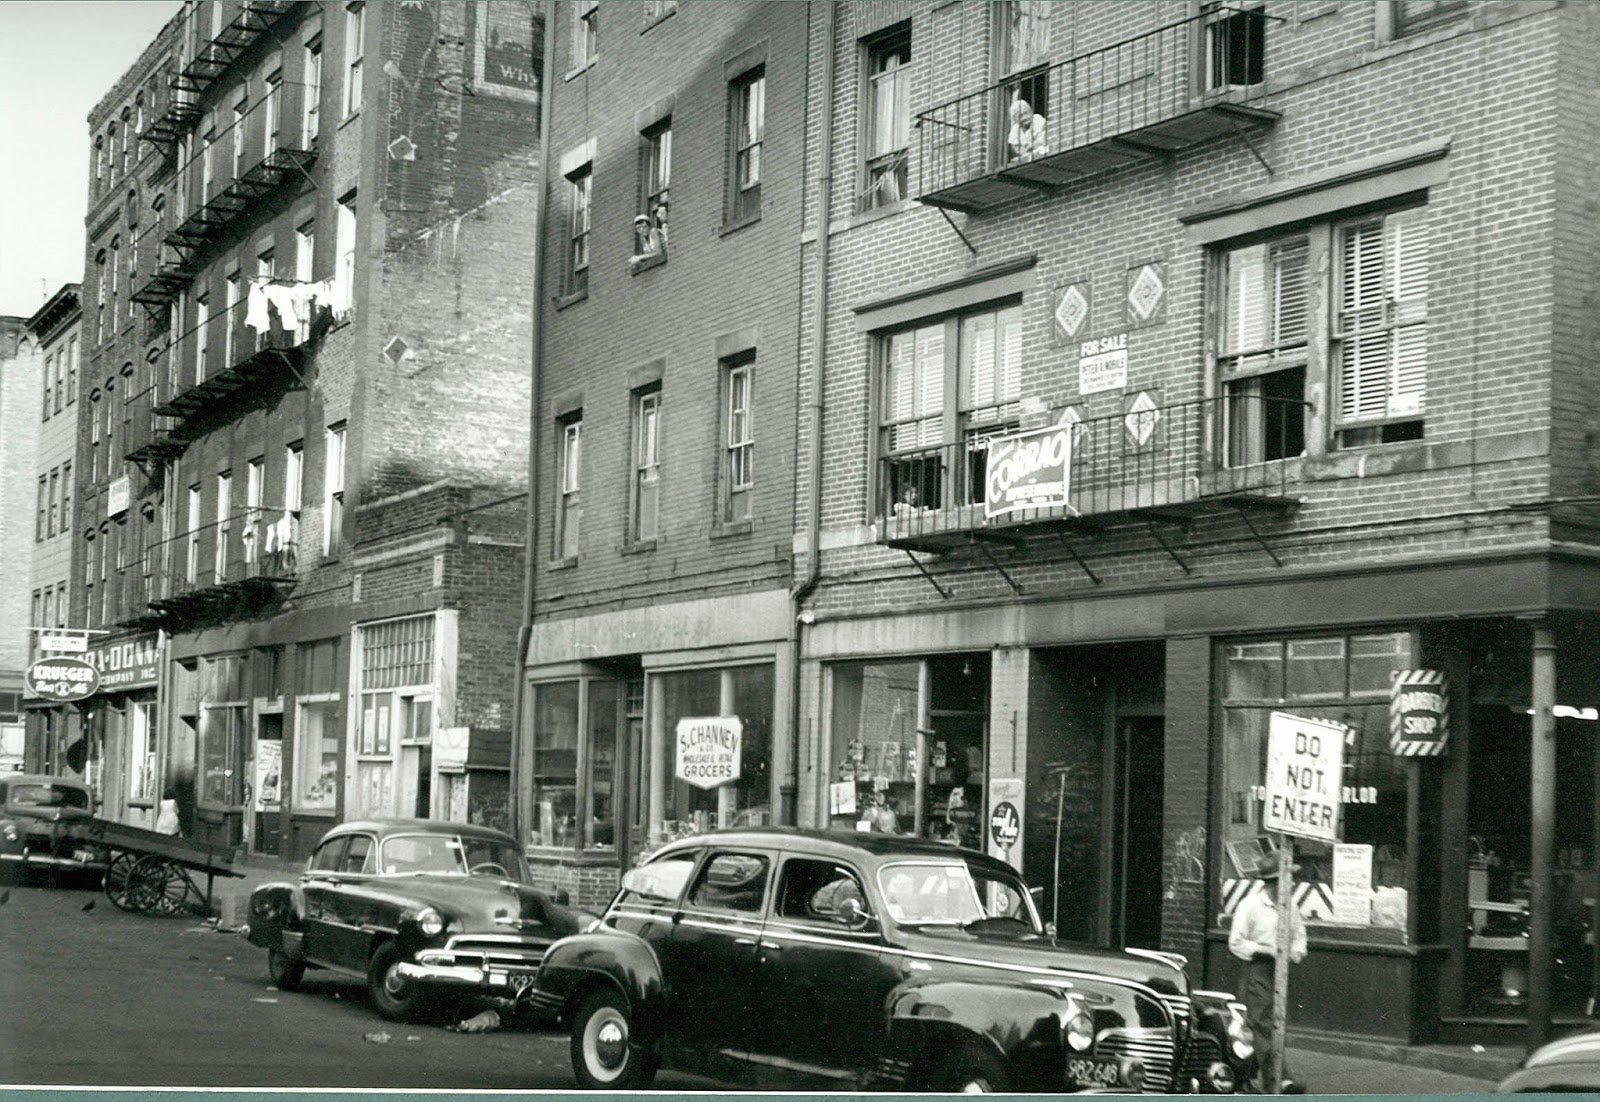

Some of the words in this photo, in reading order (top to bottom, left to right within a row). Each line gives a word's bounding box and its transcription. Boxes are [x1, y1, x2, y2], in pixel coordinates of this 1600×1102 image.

[1081, 340, 1099, 357] FOR
[1100, 333, 1127, 352] SALE
[33, 665, 94, 682] KRUEGER
[1403, 716, 1437, 734] SHOP
[1295, 731, 1321, 758] DO
[684, 764, 732, 778] GROCERS
[1287, 764, 1324, 793] NOT
[1341, 786, 1378, 804] RLOR
[1272, 794, 1332, 829] ENTER
